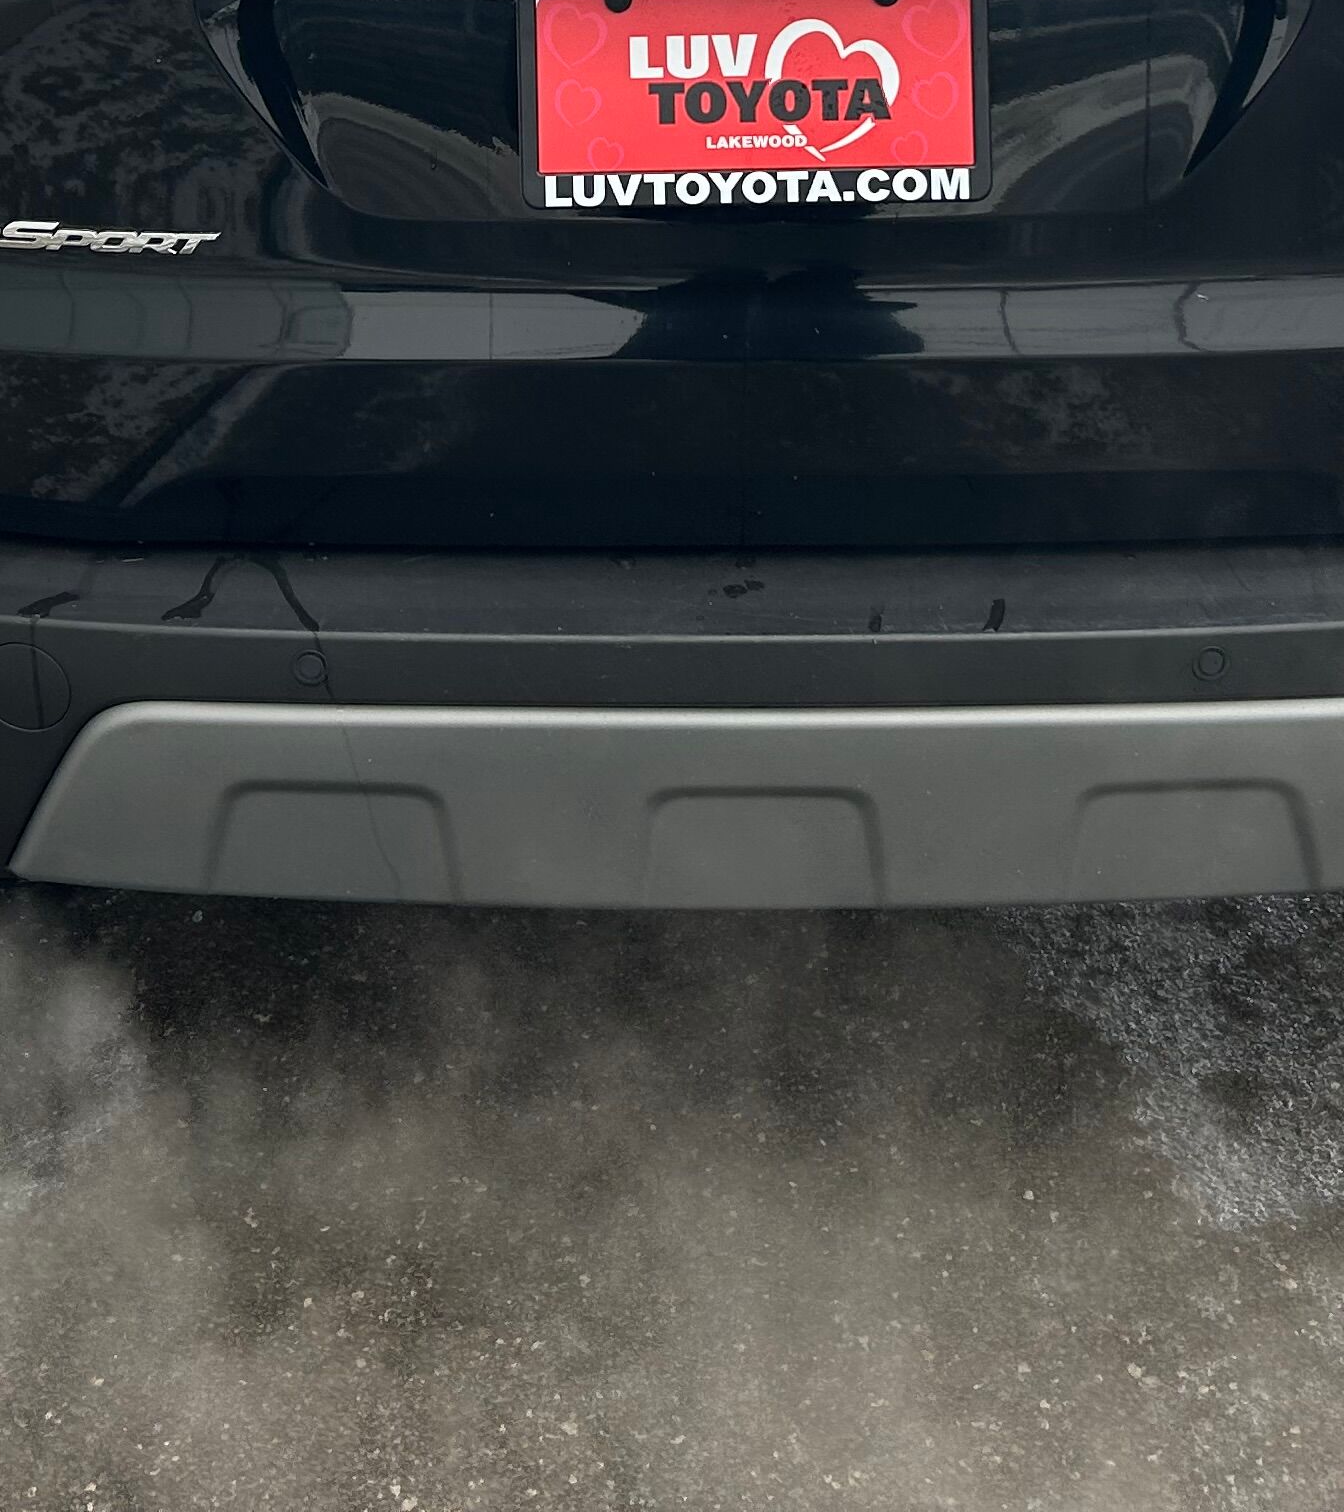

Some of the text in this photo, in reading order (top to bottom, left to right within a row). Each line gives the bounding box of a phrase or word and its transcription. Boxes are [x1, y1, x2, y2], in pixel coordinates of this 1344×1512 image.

[628, 33, 758, 79] LUV
[648, 78, 892, 125] TOYOTA
[706, 134, 809, 149] LAKEWOOD
[544, 168, 971, 208] LUVTOYOTA.COM
